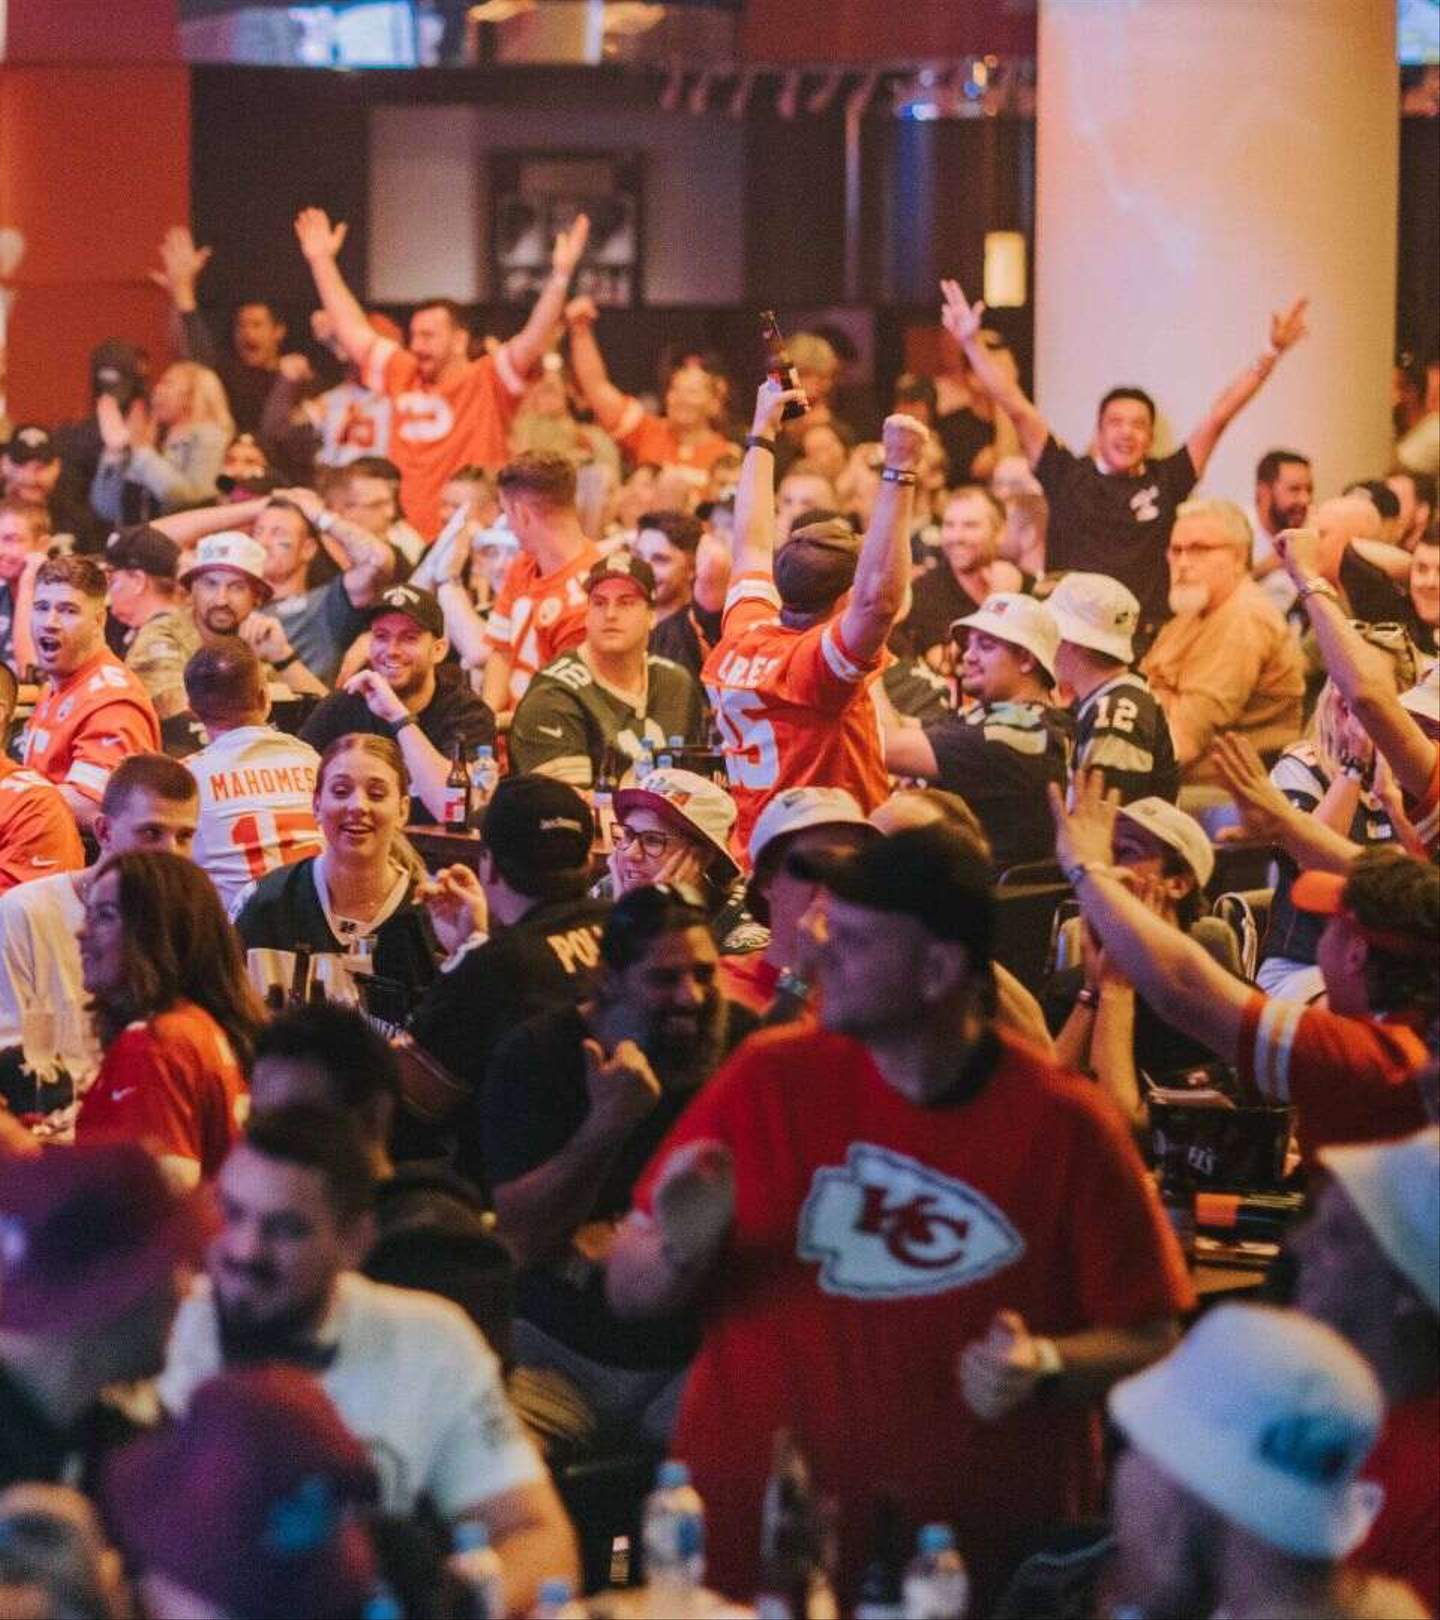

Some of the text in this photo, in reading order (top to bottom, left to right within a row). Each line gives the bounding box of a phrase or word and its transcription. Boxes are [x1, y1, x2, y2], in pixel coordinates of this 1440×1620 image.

[1093, 695, 1138, 733] 12
[210, 766, 316, 802] MAHOMES
[230, 811, 322, 880] 15
[852, 1183, 970, 1270] KC
